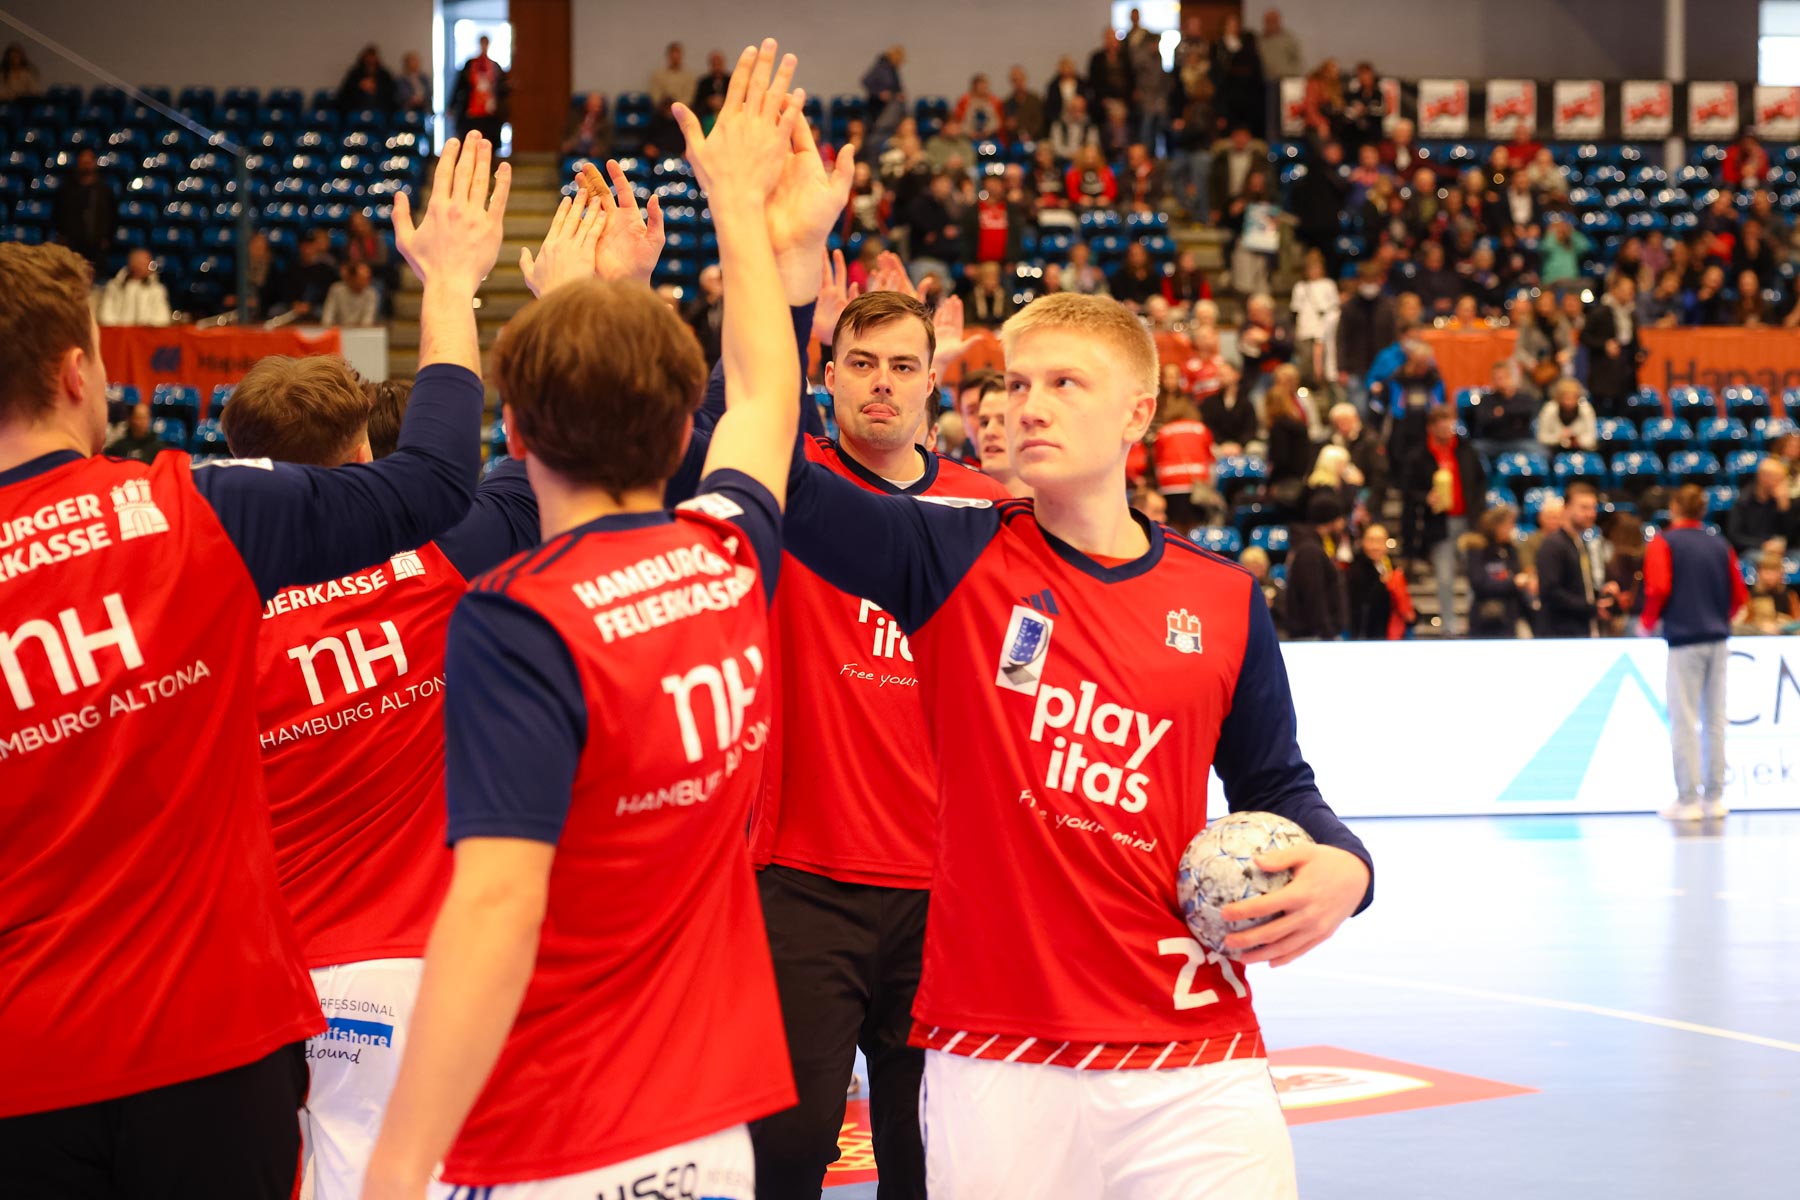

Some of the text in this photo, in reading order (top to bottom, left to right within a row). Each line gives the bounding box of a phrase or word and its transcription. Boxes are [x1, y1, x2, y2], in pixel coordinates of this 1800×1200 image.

[0, 522, 112, 583] KASSE
[286, 619, 408, 706] nH
[839, 663, 919, 688] Free your
[0, 659, 211, 763] MBURG ALTONA
[259, 702, 374, 749] HAMBURG
[1029, 679, 1174, 771] play
[1045, 735, 1151, 814] itas
[1055, 813, 1105, 833] your
[1111, 830, 1158, 853] mind
[1156, 936, 1248, 1011] 21
